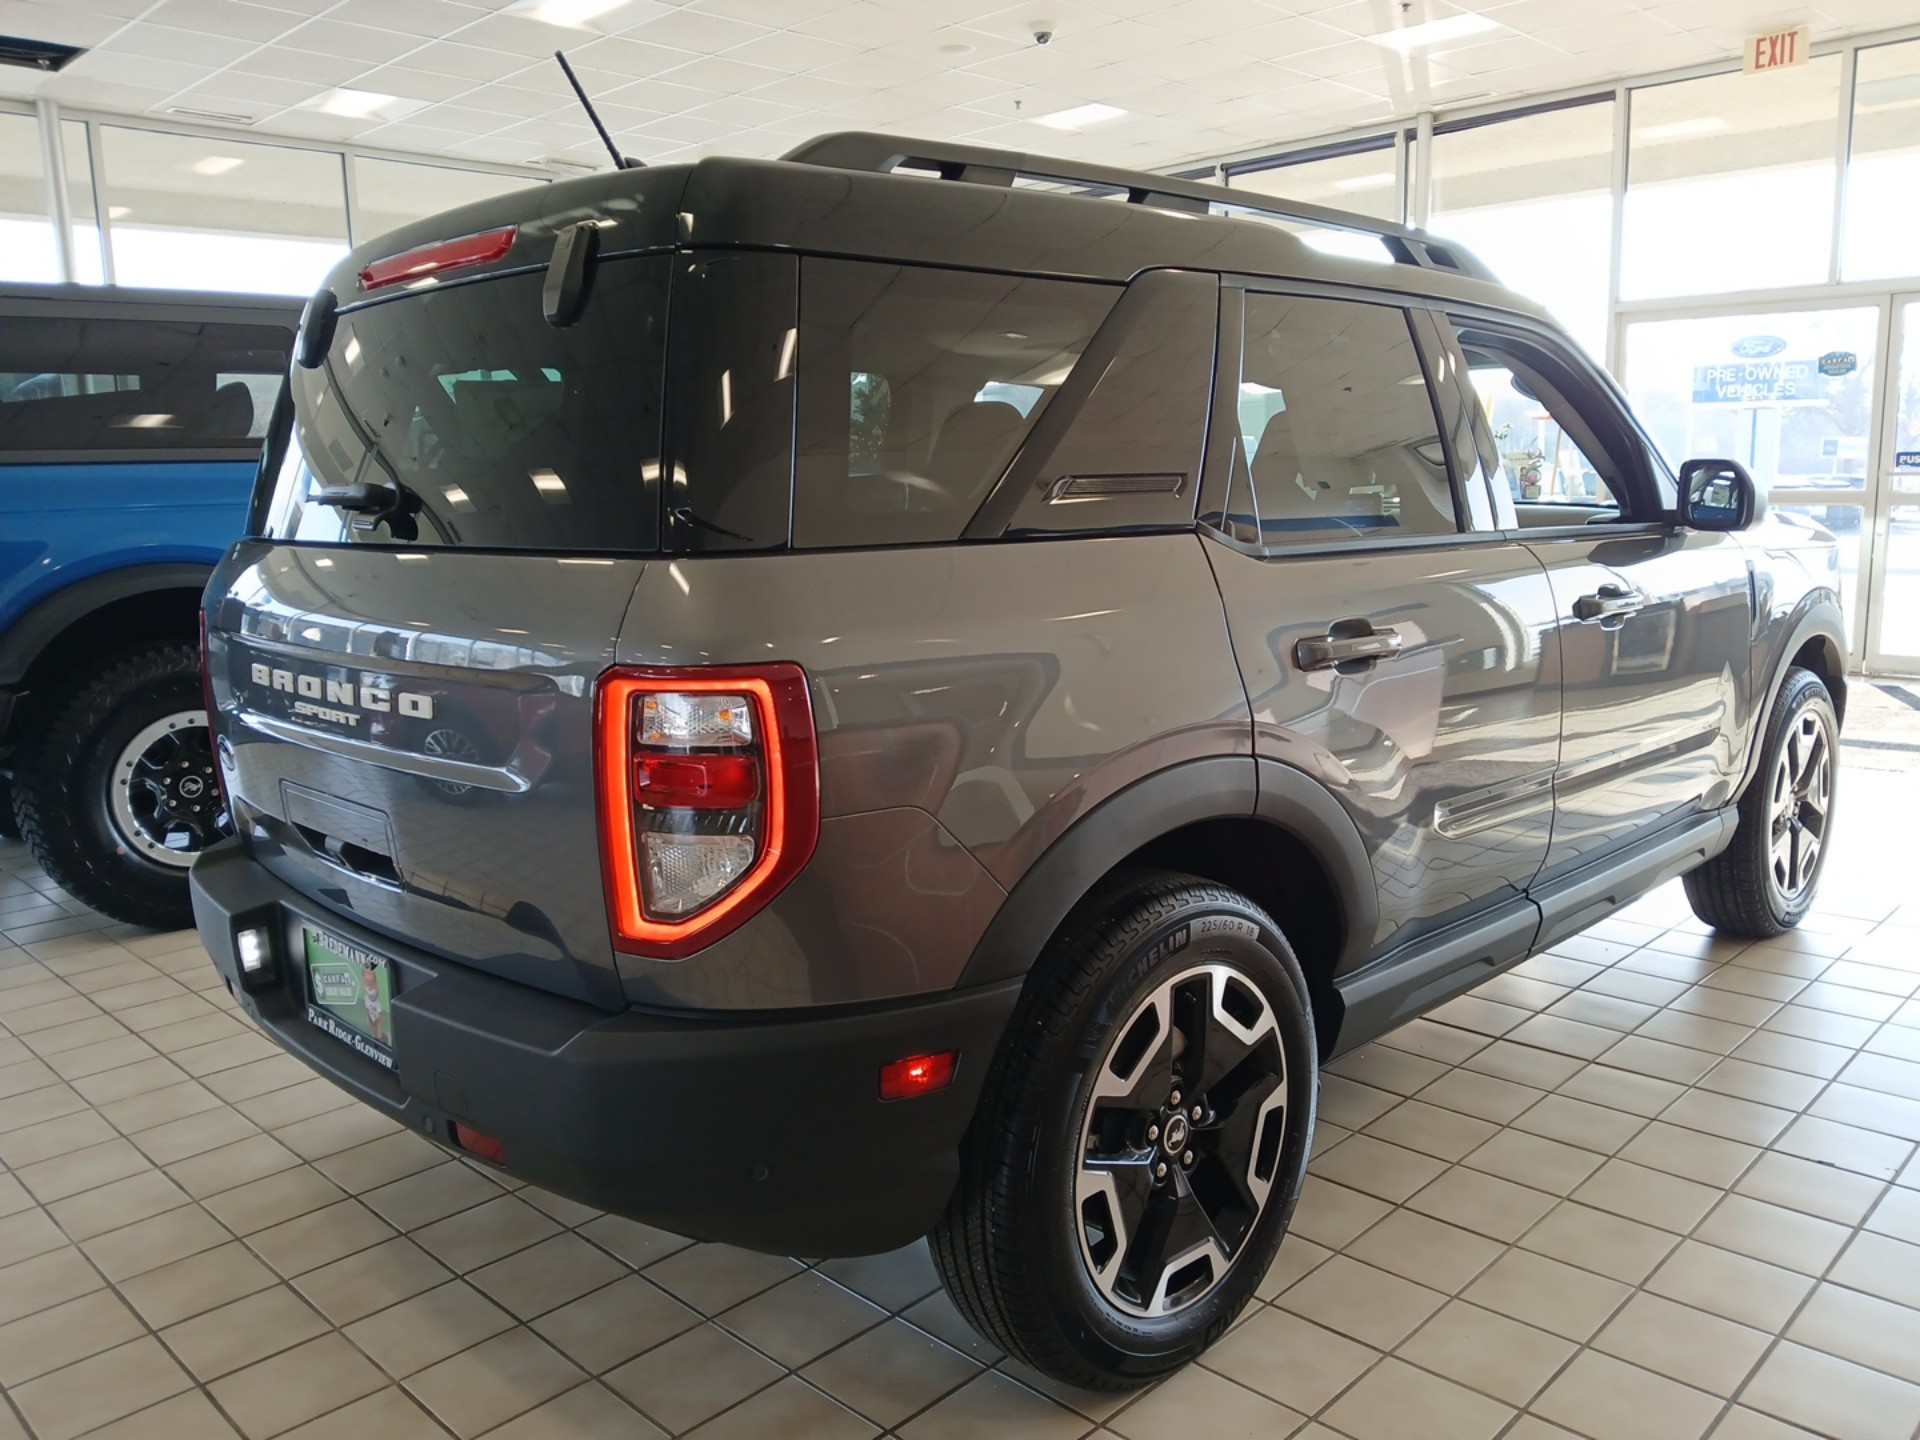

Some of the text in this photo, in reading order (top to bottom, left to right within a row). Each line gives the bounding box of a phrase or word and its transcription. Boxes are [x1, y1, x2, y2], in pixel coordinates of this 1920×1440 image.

[1755, 31, 1798, 70] EXIT
[1707, 364, 1809, 382] PRE-OWNED
[1716, 382, 1797, 399] VEHICLES
[251, 662, 434, 720] BRONCO
[293, 700, 361, 727] SPORT
[1201, 919, 1254, 937] 225/60 R 18
[1112, 928, 1187, 998] ICHELIN
